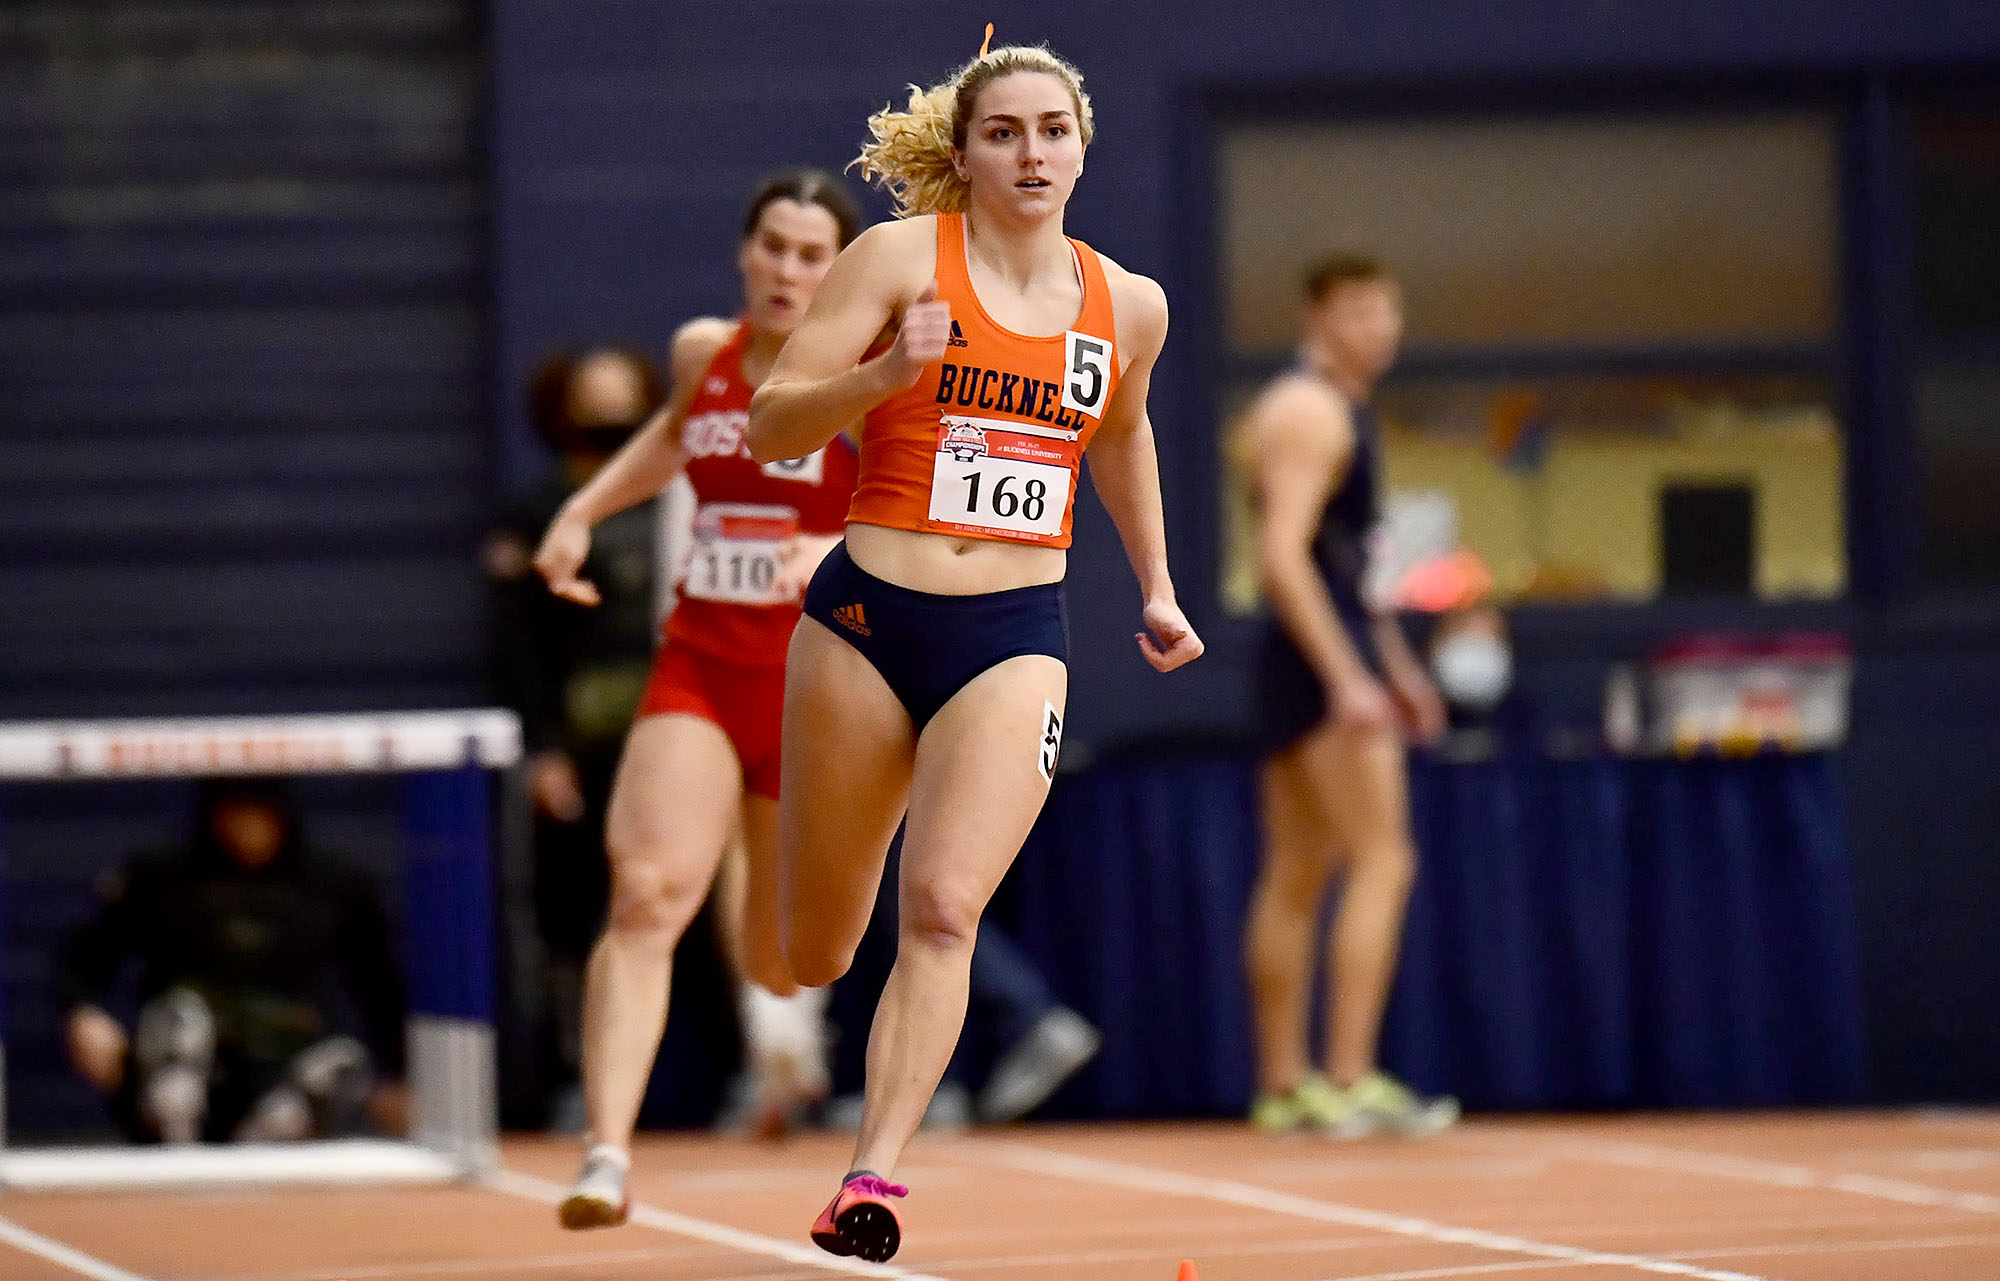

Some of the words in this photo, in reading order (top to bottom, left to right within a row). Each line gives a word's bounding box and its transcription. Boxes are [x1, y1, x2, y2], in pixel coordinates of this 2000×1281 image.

[1070, 338, 1104, 408] 5
[1003, 446, 1031, 455] BUCKNELL
[1031, 449, 1063, 460] UNIVERSITY
[962, 471, 1046, 521] 168
[706, 554, 774, 591] 110
[832, 608, 873, 637] adidas
[1043, 709, 1060, 780] 5
